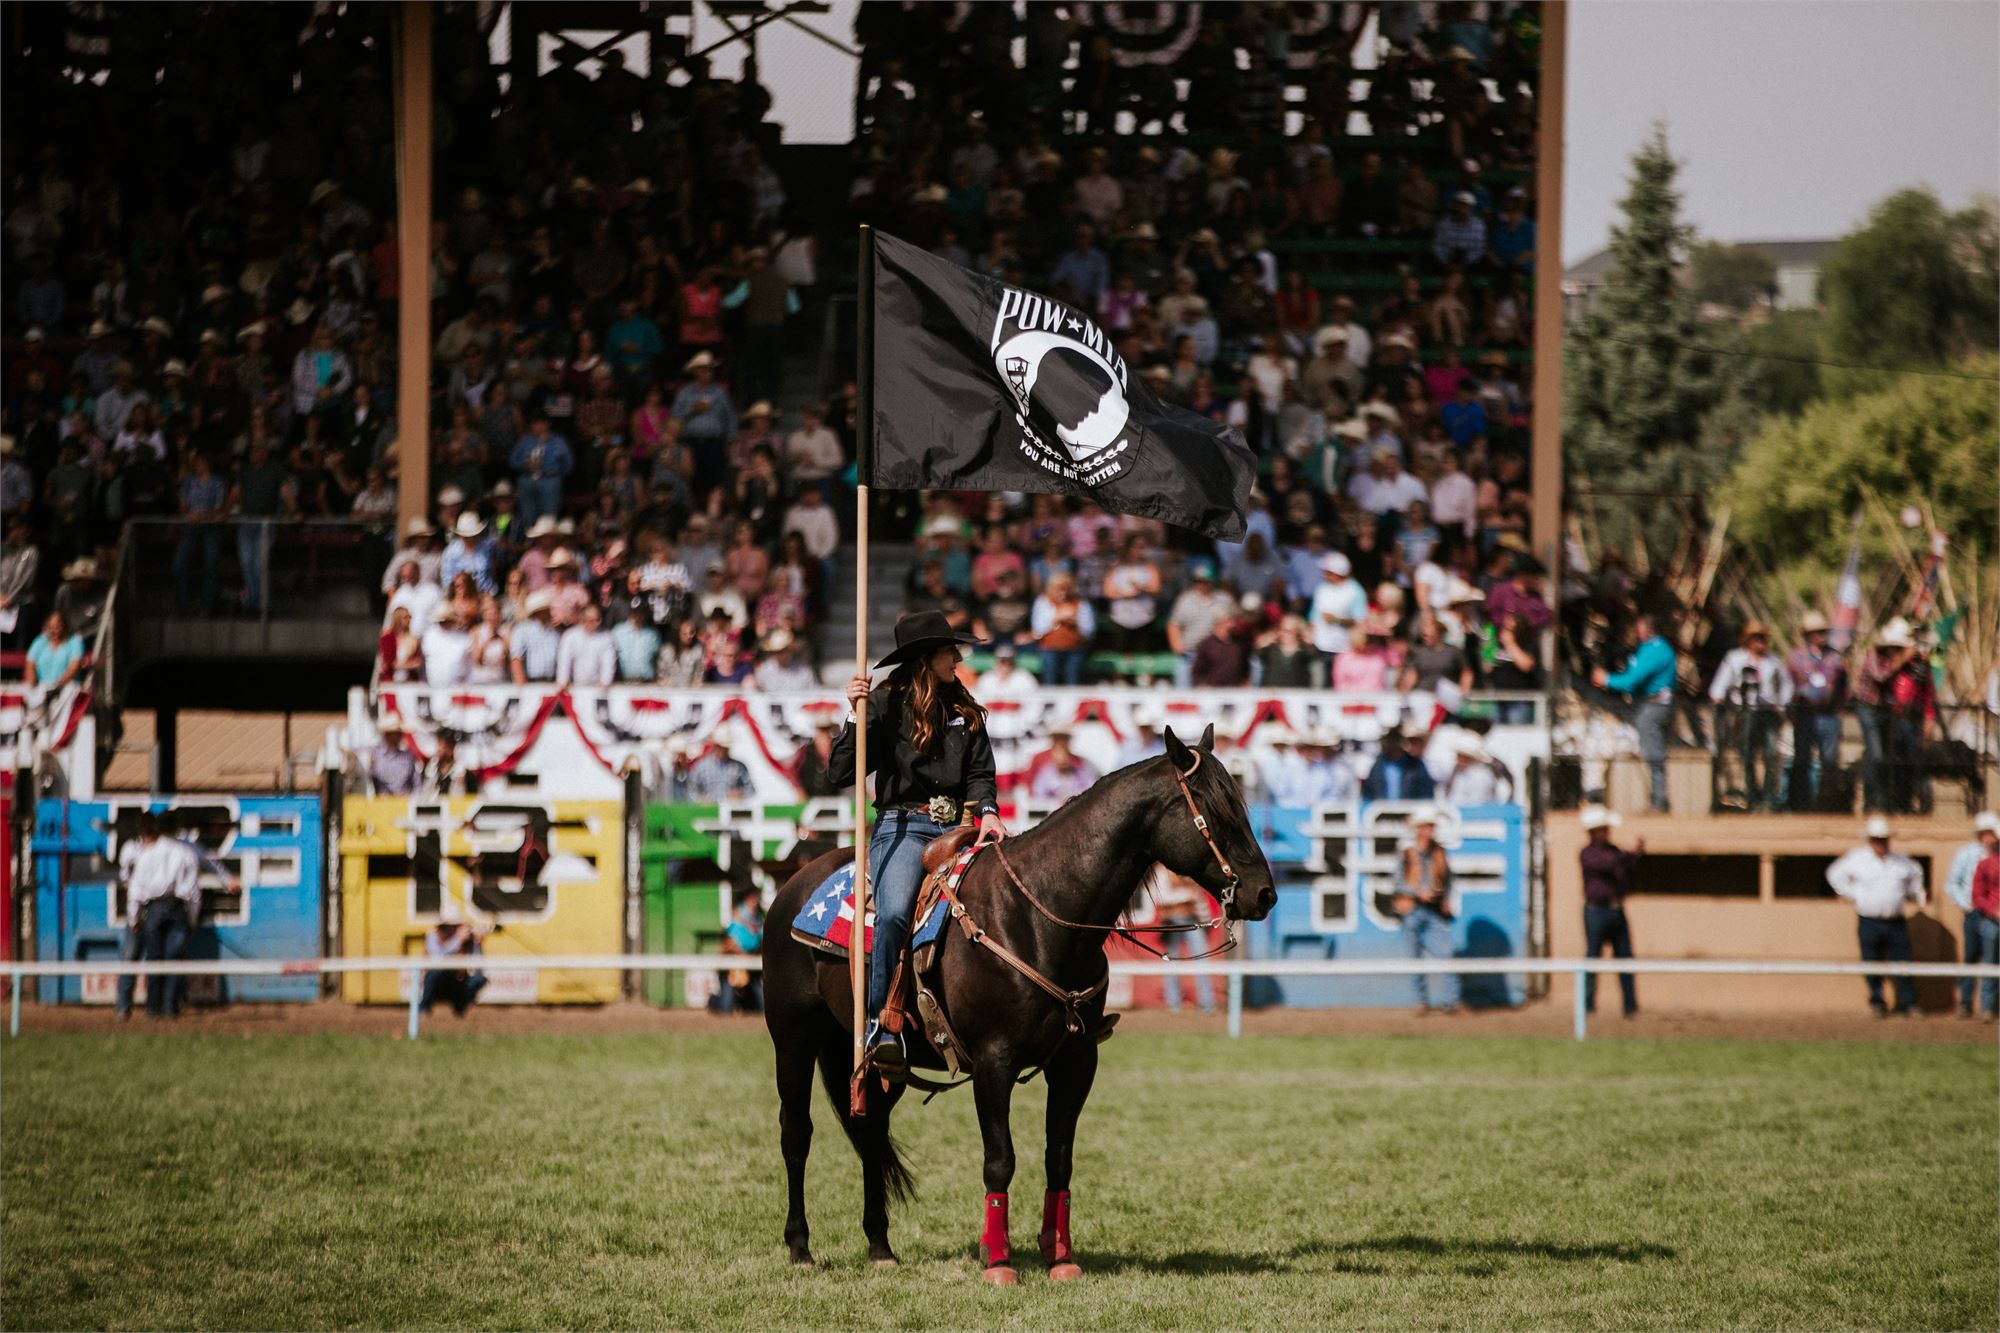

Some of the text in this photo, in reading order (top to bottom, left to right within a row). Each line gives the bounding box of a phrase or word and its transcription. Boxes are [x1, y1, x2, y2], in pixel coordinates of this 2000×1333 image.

[991, 287, 1127, 394] POW MIA
[1019, 440, 1122, 487] YOU ARE NOT OTTEN
